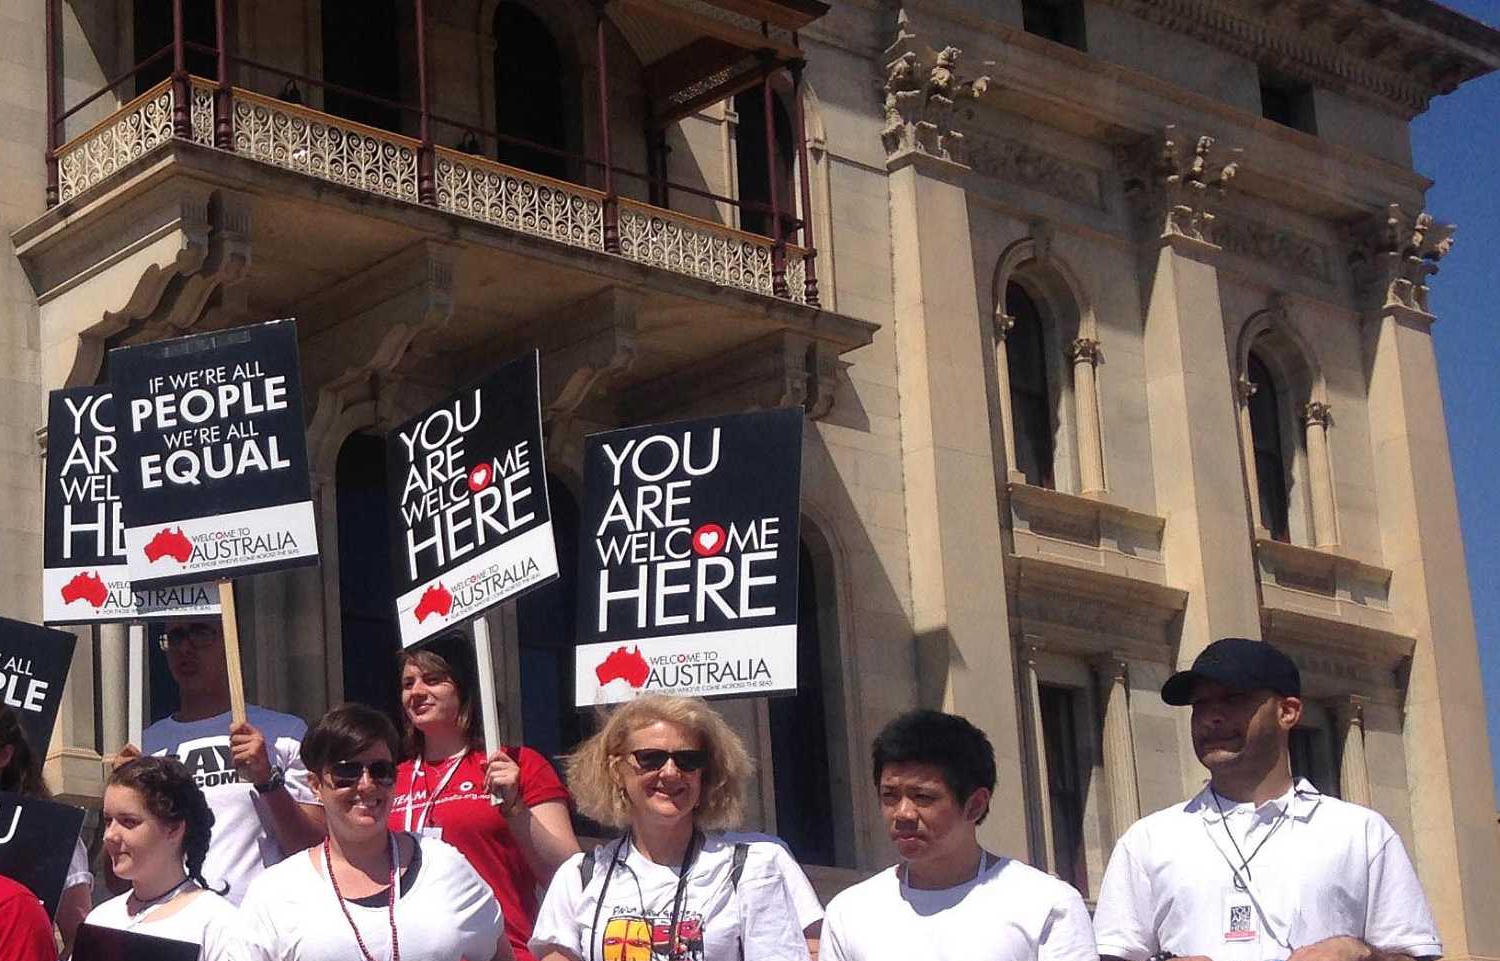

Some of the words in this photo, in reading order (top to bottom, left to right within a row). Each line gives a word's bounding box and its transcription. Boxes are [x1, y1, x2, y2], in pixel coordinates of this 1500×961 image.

[149, 378, 164, 394] IF
[169, 368, 226, 390] WE'RE
[232, 360, 265, 381] ALL
[64, 393, 116, 435] YO
[131, 375, 288, 432] PEOPLE
[399, 389, 482, 463] YOU
[60, 435, 118, 477] AR
[163, 428, 220, 450] WE'RE
[226, 421, 259, 440] ALL
[602, 427, 722, 486] YOU
[140, 435, 291, 489] EQUAL
[401, 436, 466, 506] ARE
[401, 440, 531, 528] WELCOME
[407, 467, 535, 582] HERE
[596, 480, 692, 537] ARE
[190, 530, 298, 562] AUSTRALIA
[191, 529, 236, 543] WELCOME
[237, 527, 251, 537] TO
[596, 517, 780, 567] WELCOME
[104, 586, 210, 609] AUSTRALIA
[451, 556, 540, 614] AUSTRALIA
[598, 550, 778, 633] HERE
[3, 656, 33, 676] ALL
[646, 658, 771, 688] AUSTRALIA
[649, 651, 701, 665] WELCOME
[703, 650, 718, 661] TO
